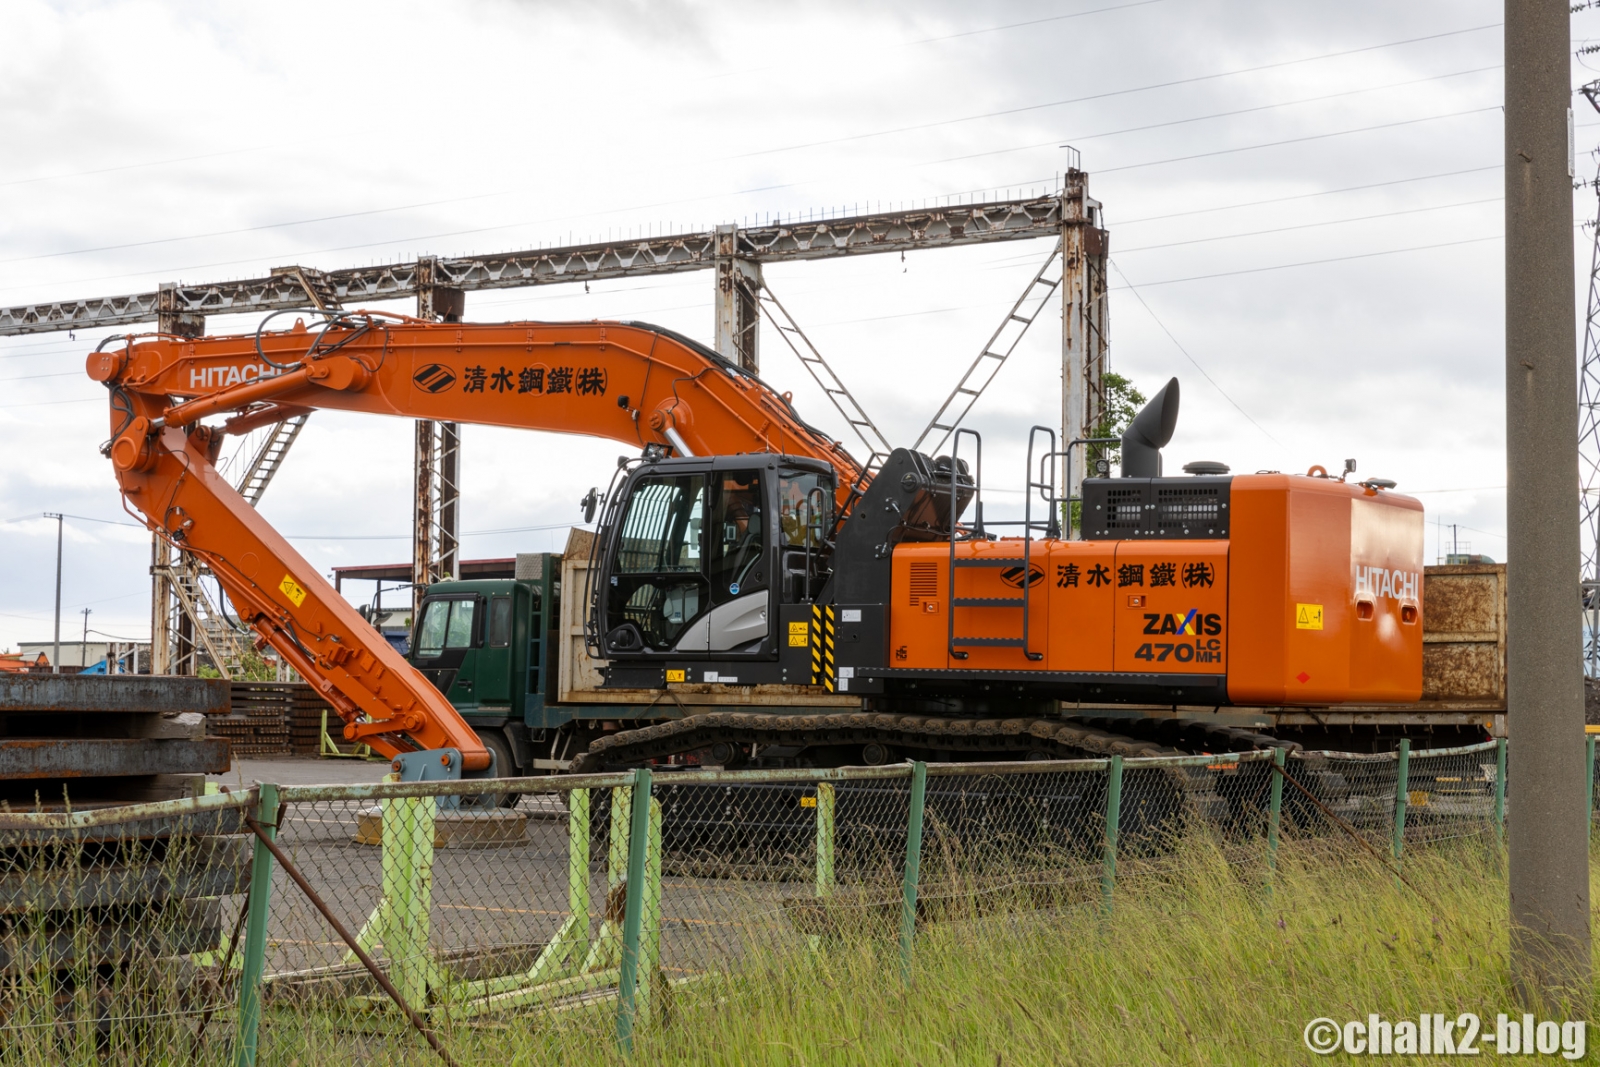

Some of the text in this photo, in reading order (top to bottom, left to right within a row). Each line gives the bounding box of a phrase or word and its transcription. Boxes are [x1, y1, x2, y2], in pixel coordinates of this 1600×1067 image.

[1356, 565, 1418, 600] HITACHI
[1143, 608, 1222, 636] ZAXIS
[1134, 639, 1221, 663] 470 LC
[1196, 652, 1221, 663] MH
